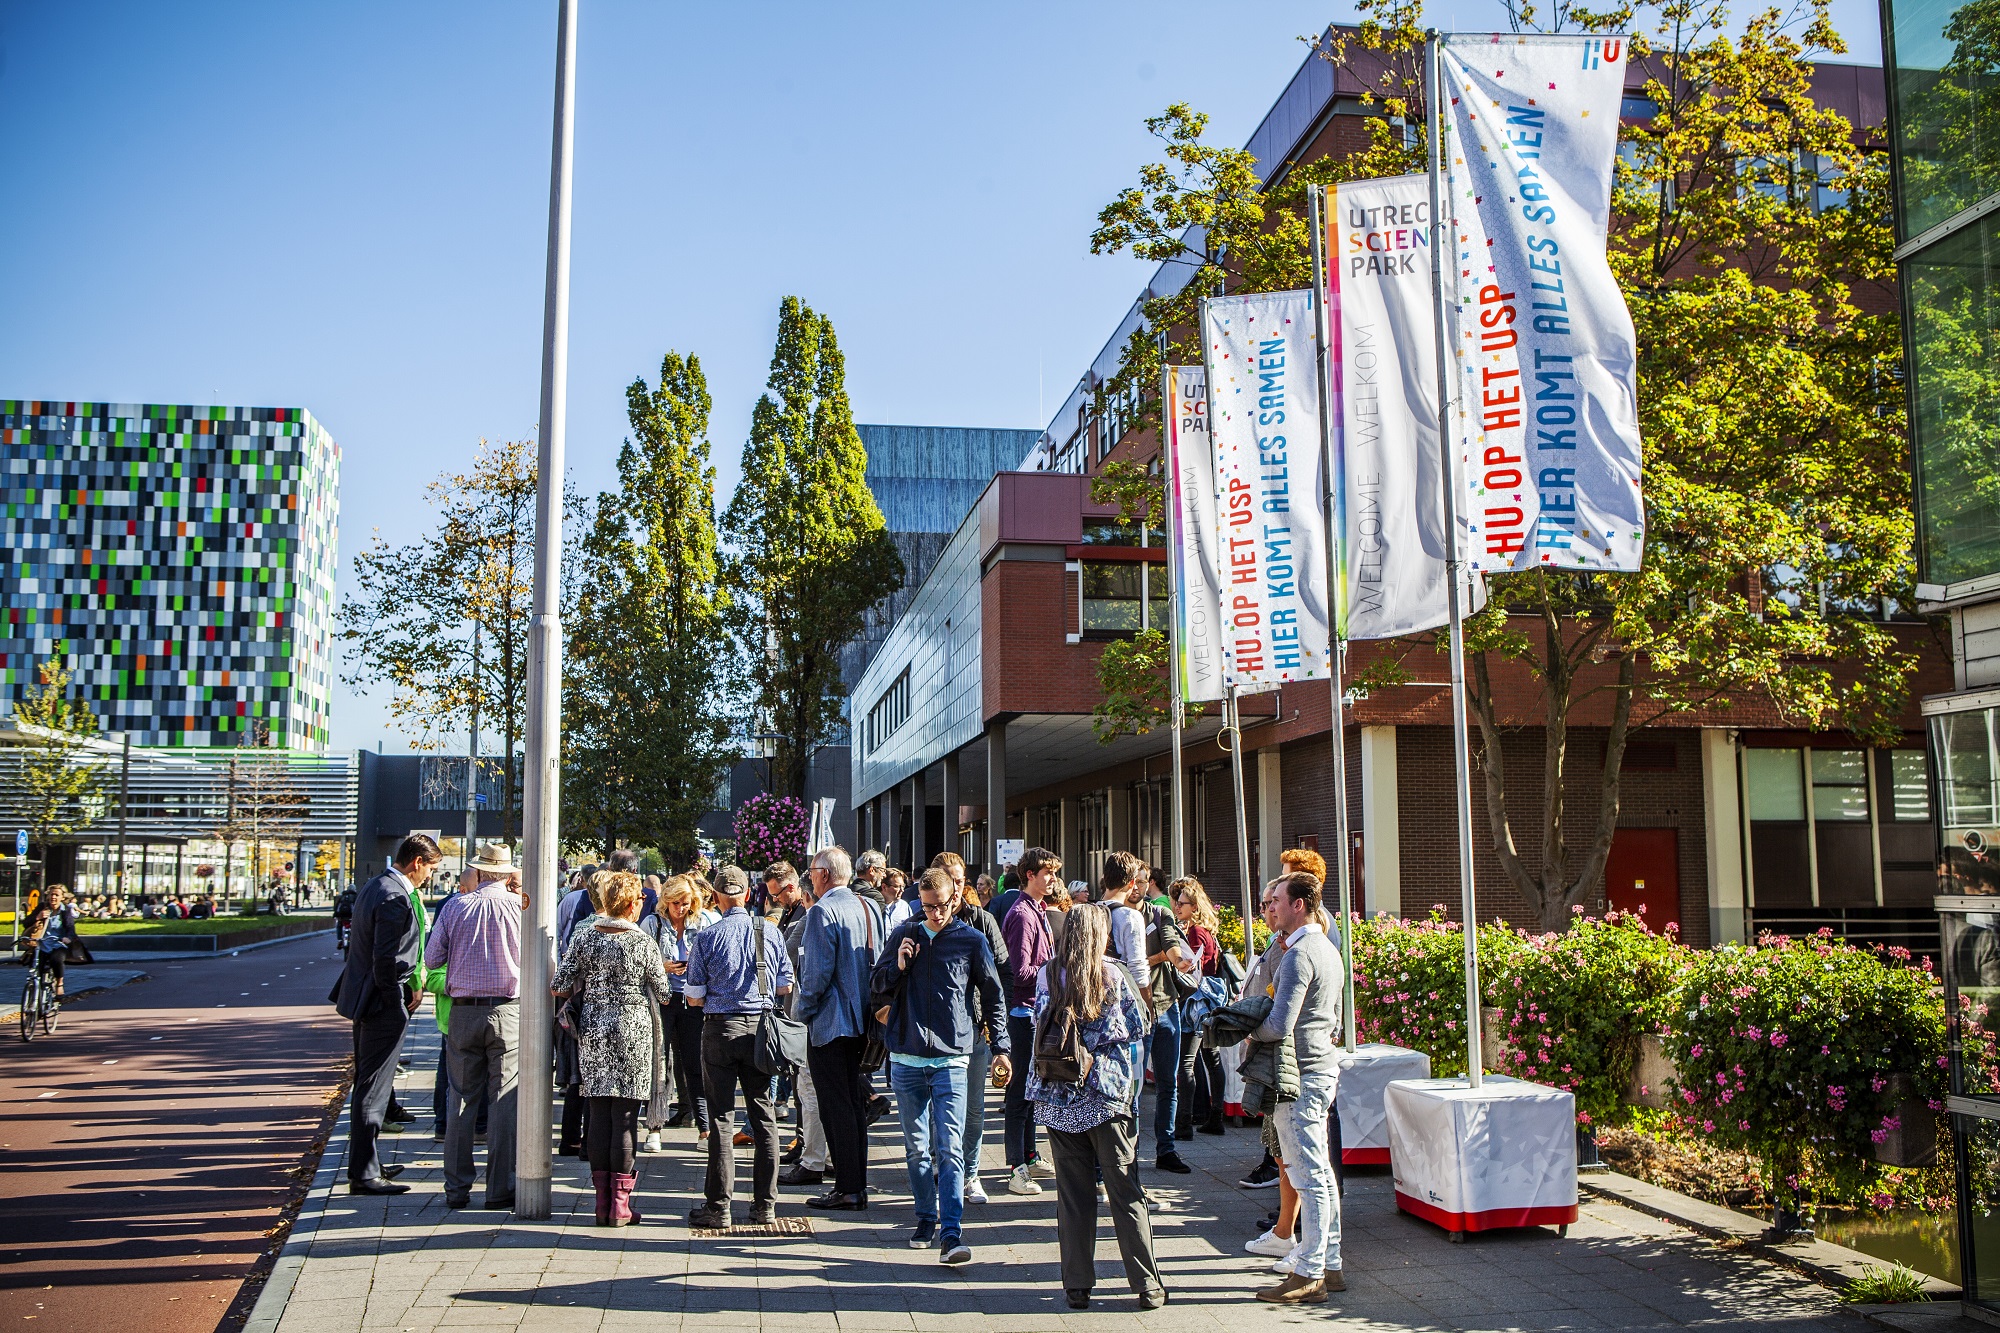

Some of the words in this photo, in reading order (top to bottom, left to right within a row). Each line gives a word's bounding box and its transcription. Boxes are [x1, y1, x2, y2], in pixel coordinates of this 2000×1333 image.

[1349, 200, 1446, 228] UTREC
[1349, 226, 1446, 254] SCIEN
[1350, 253, 1415, 278] PARK
[1527, 234, 1571, 335] ALLES
[1479, 284, 1518, 352] USP
[1258, 338, 1286, 426] SAMEN
[1354, 323, 1379, 447] WELKOM
[1482, 367, 1521, 432] HET
[1534, 348, 1577, 451] KOMT
[1229, 477, 1253, 527] USP
[1259, 435, 1290, 513] ALLES
[1535, 467, 1576, 549] HIER
[1182, 466, 1202, 559] WELKOM
[1357, 472, 1383, 615] WELCOME
[1229, 536, 1257, 585] HET
[1263, 524, 1295, 599] KOMT
[1190, 576, 1212, 683] WELCOME
[1269, 608, 1301, 669] HIER
